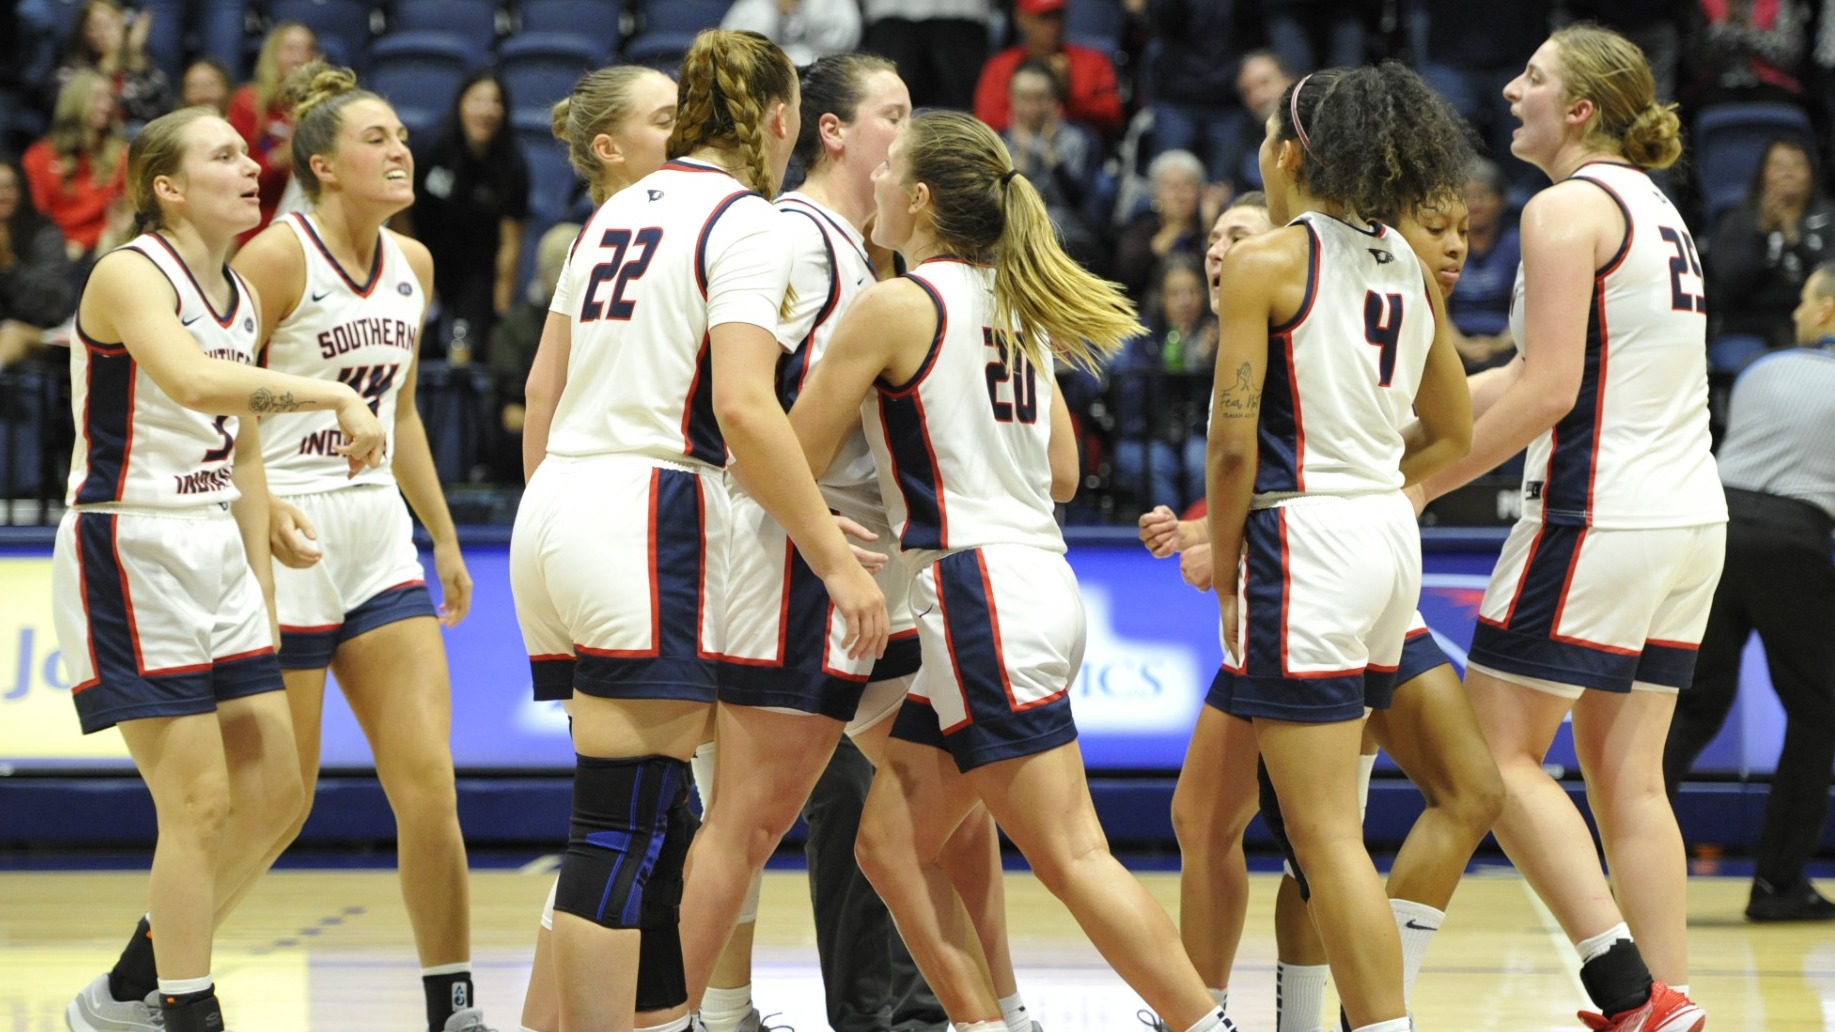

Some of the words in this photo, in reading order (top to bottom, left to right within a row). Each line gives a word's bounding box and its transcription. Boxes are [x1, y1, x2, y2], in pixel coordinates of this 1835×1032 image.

[580, 226, 664, 323] 22
[317, 317, 416, 359] SOUTHERN
[982, 326, 1038, 425] 20
[1363, 289, 1404, 388] 4
[174, 465, 232, 494] INDIA
